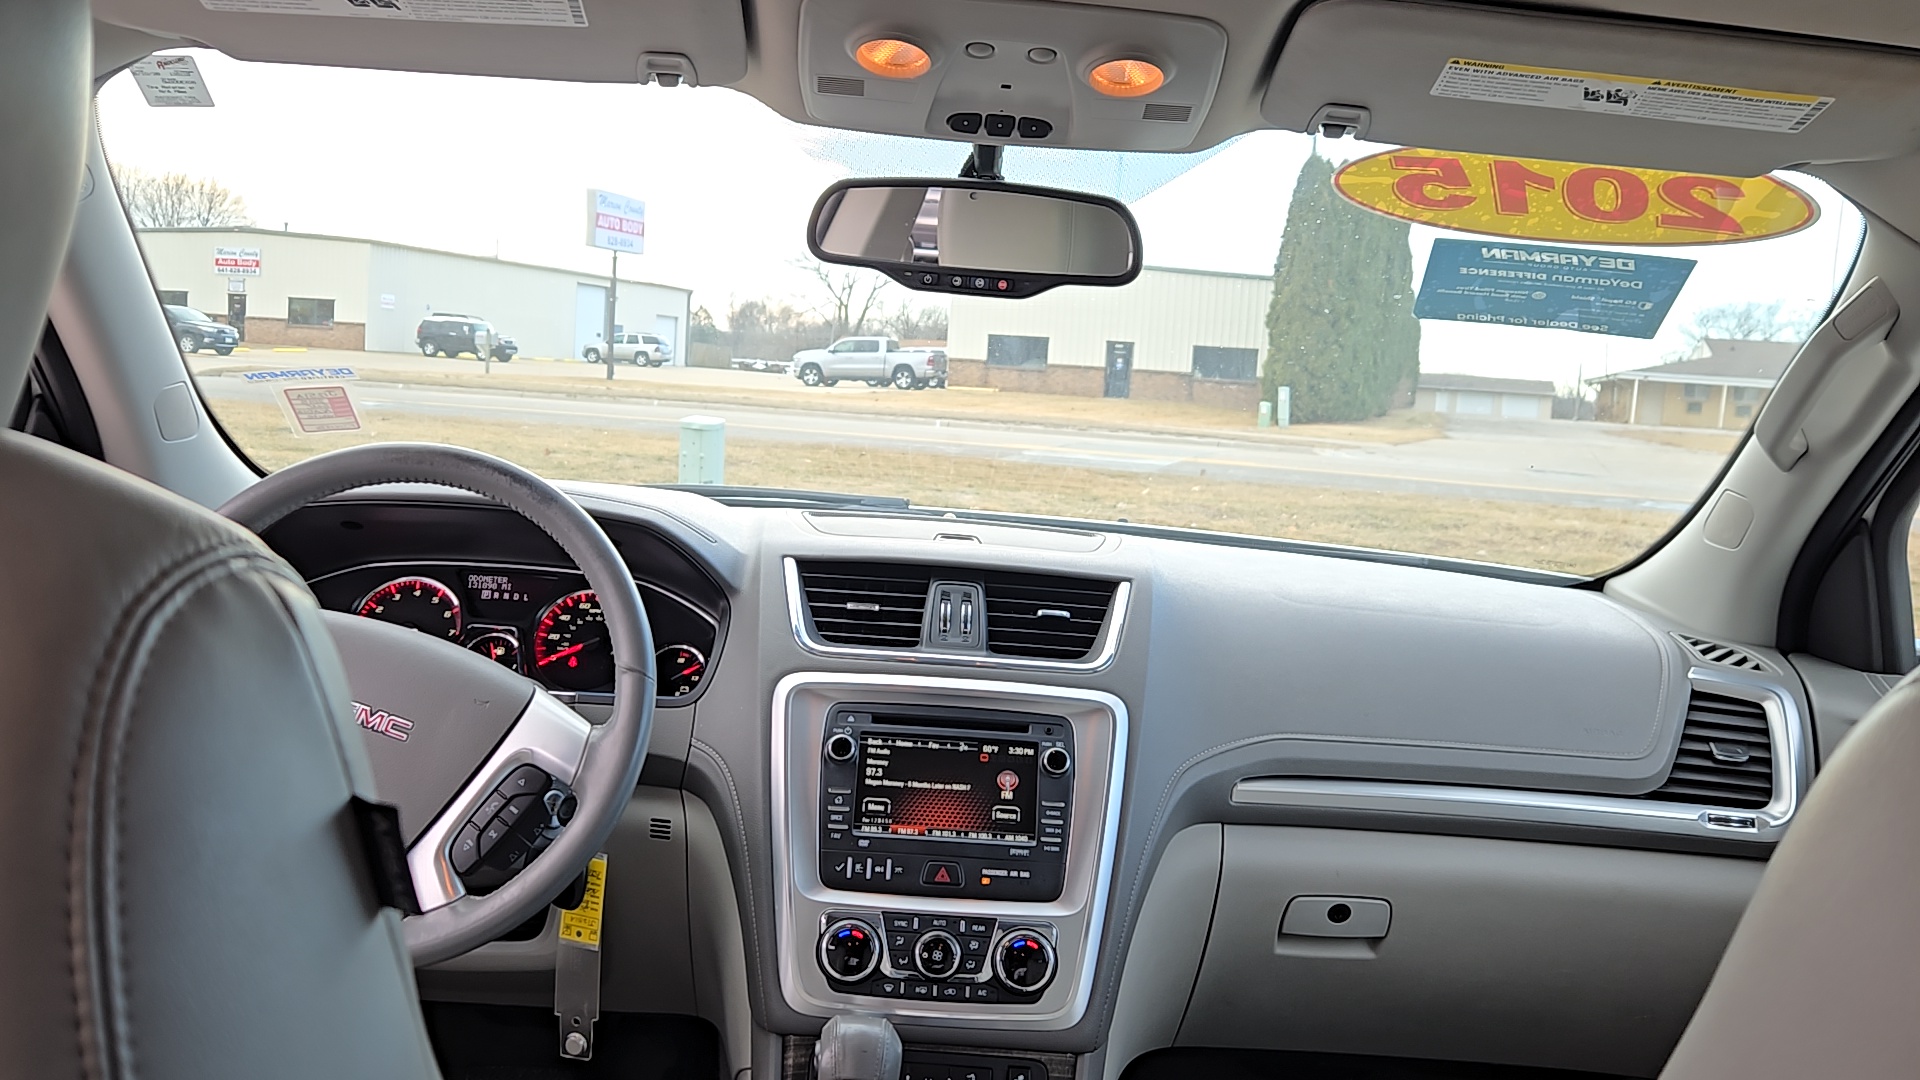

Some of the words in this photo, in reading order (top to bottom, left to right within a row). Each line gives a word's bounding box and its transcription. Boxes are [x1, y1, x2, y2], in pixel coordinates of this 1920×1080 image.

[1463, 60, 1505, 70] WARNING
[1497, 71, 1542, 80] ADVANCED
[1664, 81, 1738, 95] AVERTISSEMENT
[598, 214, 620, 231] AUTO
[622, 218, 643, 235] BODY
[218, 258, 236, 266] Auto
[237, 259, 257, 268] Body
[468, 574, 508, 584] ODOMETER
[503, 592, 510, 600] N
[523, 593, 529, 601] L
[448, 629, 456, 637] 7
[351, 700, 416, 742] MC
[867, 737, 883, 745] Back
[896, 739, 913, 748] Home
[928, 741, 940, 749] Fav
[1008, 746, 1023, 755] 3:30
[1024, 748, 1034, 756] PM
[866, 767, 883, 776] 97.3
[1000, 790, 1014, 800] FM
[867, 803, 885, 811] Menu
[996, 811, 1016, 820] Source
[893, 919, 908, 927] SYNC
[932, 919, 947, 927] AUTO
[972, 924, 986, 932] REAR
[977, 989, 988, 997] A/C
